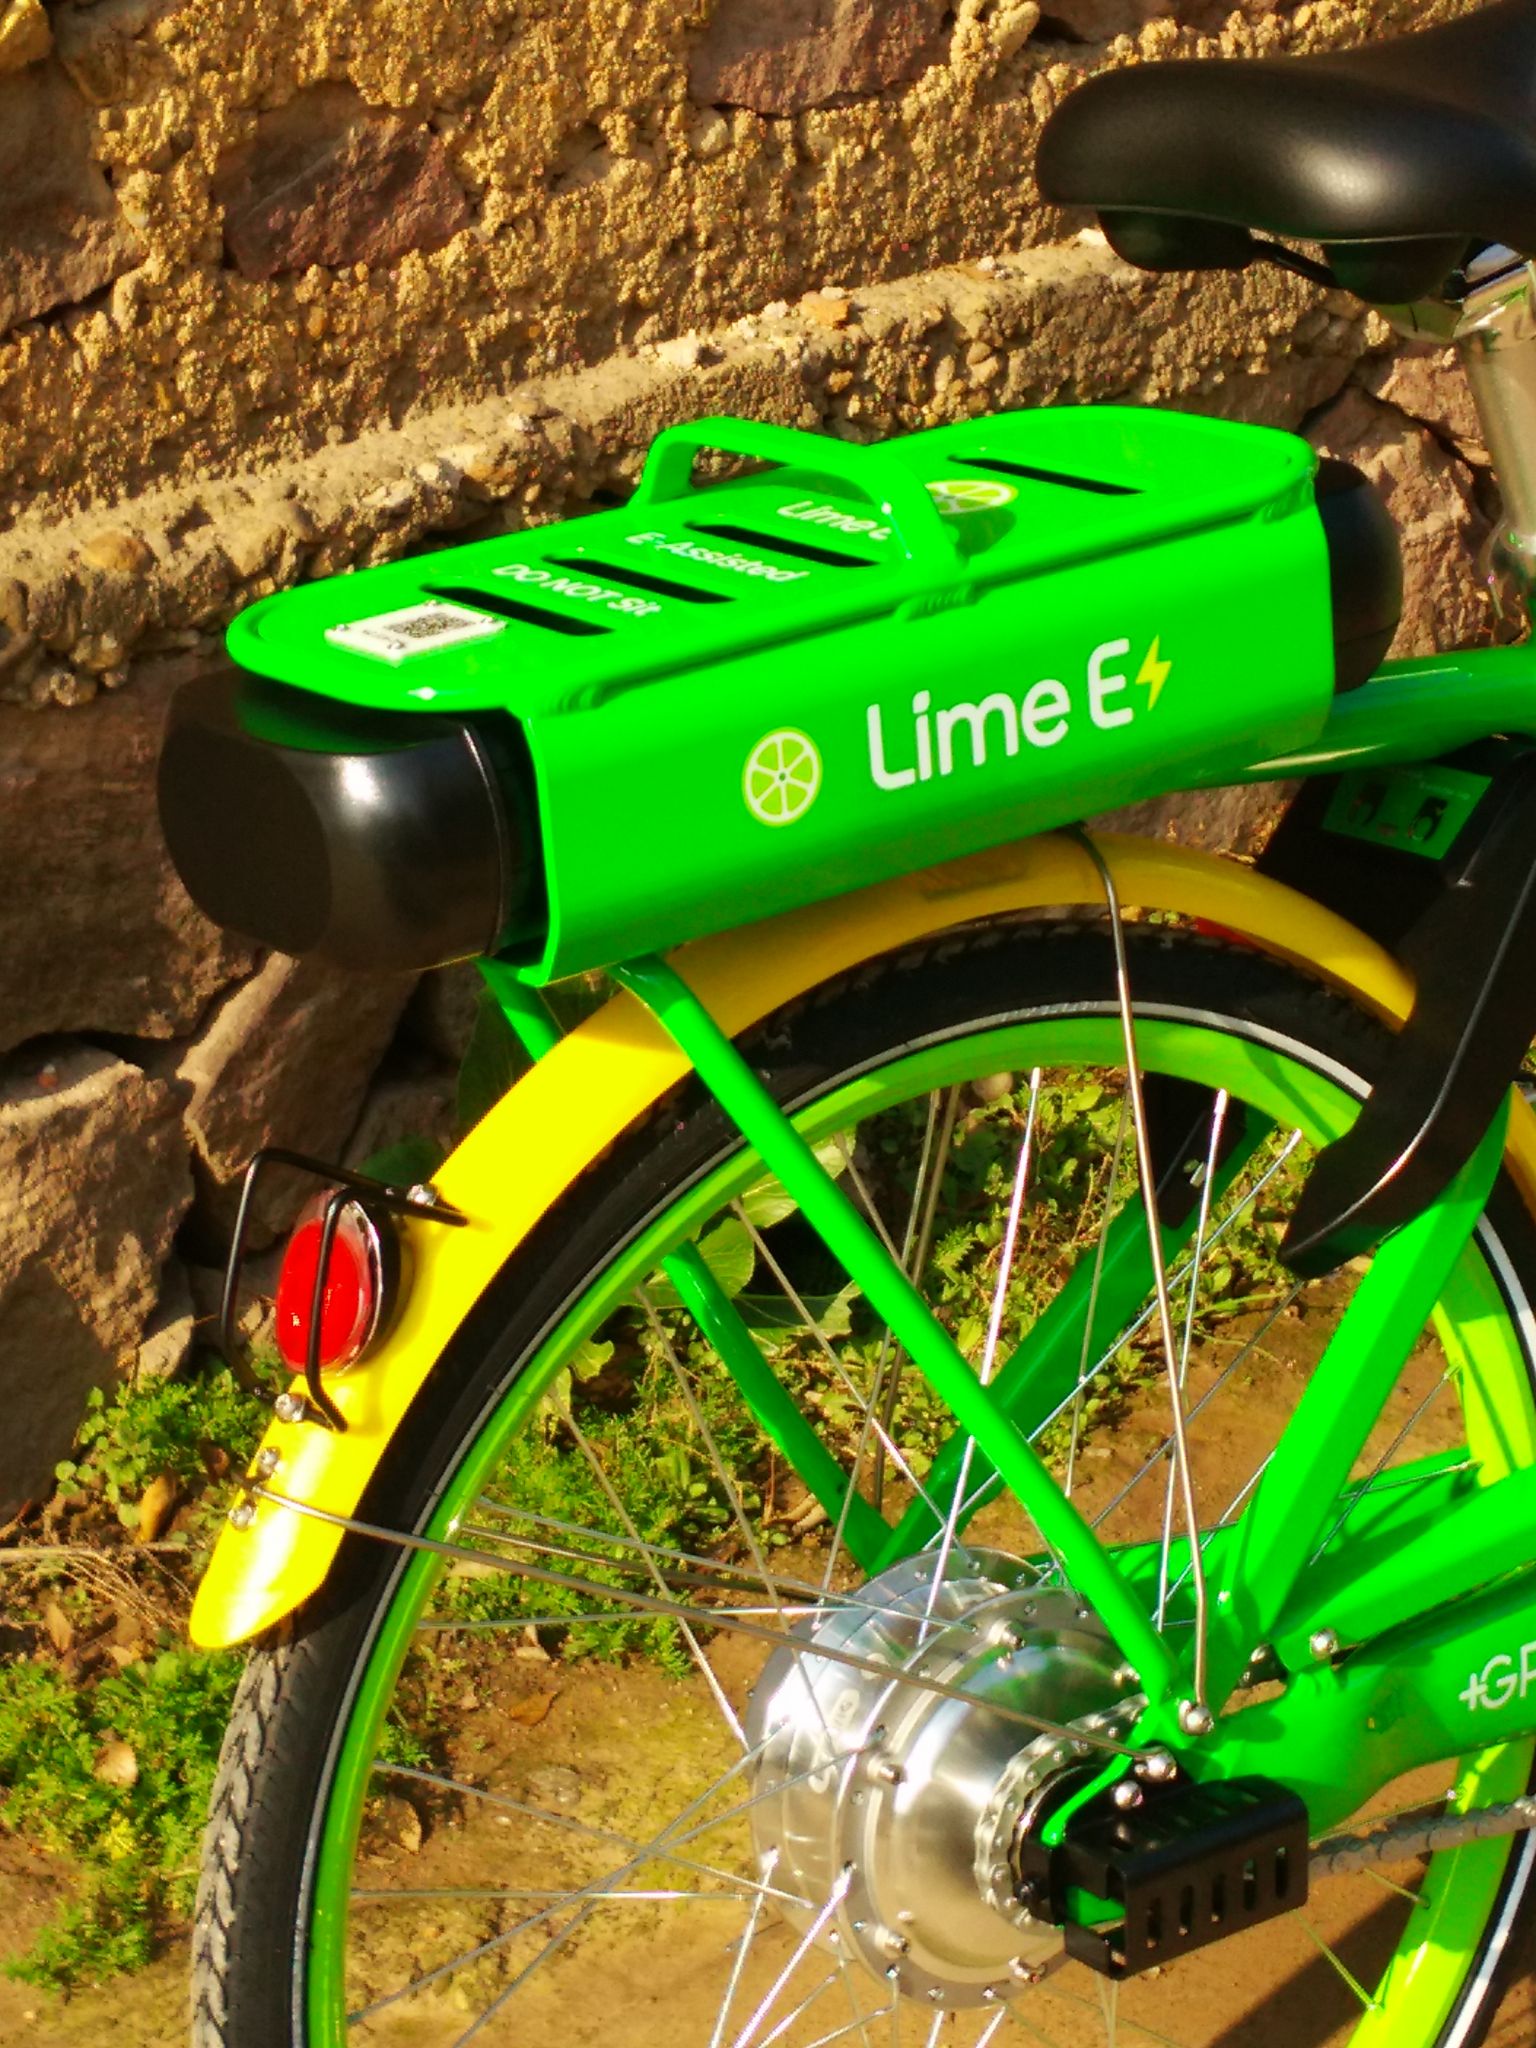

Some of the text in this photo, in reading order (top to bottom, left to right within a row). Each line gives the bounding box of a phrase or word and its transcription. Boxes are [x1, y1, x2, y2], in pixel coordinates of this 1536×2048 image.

[776, 500, 878, 534] Lime
[625, 532, 810, 582] E-Assisted
[491, 563, 552, 583] DO
[539, 577, 623, 603] NOT
[866, 638, 1134, 791] Lime E
